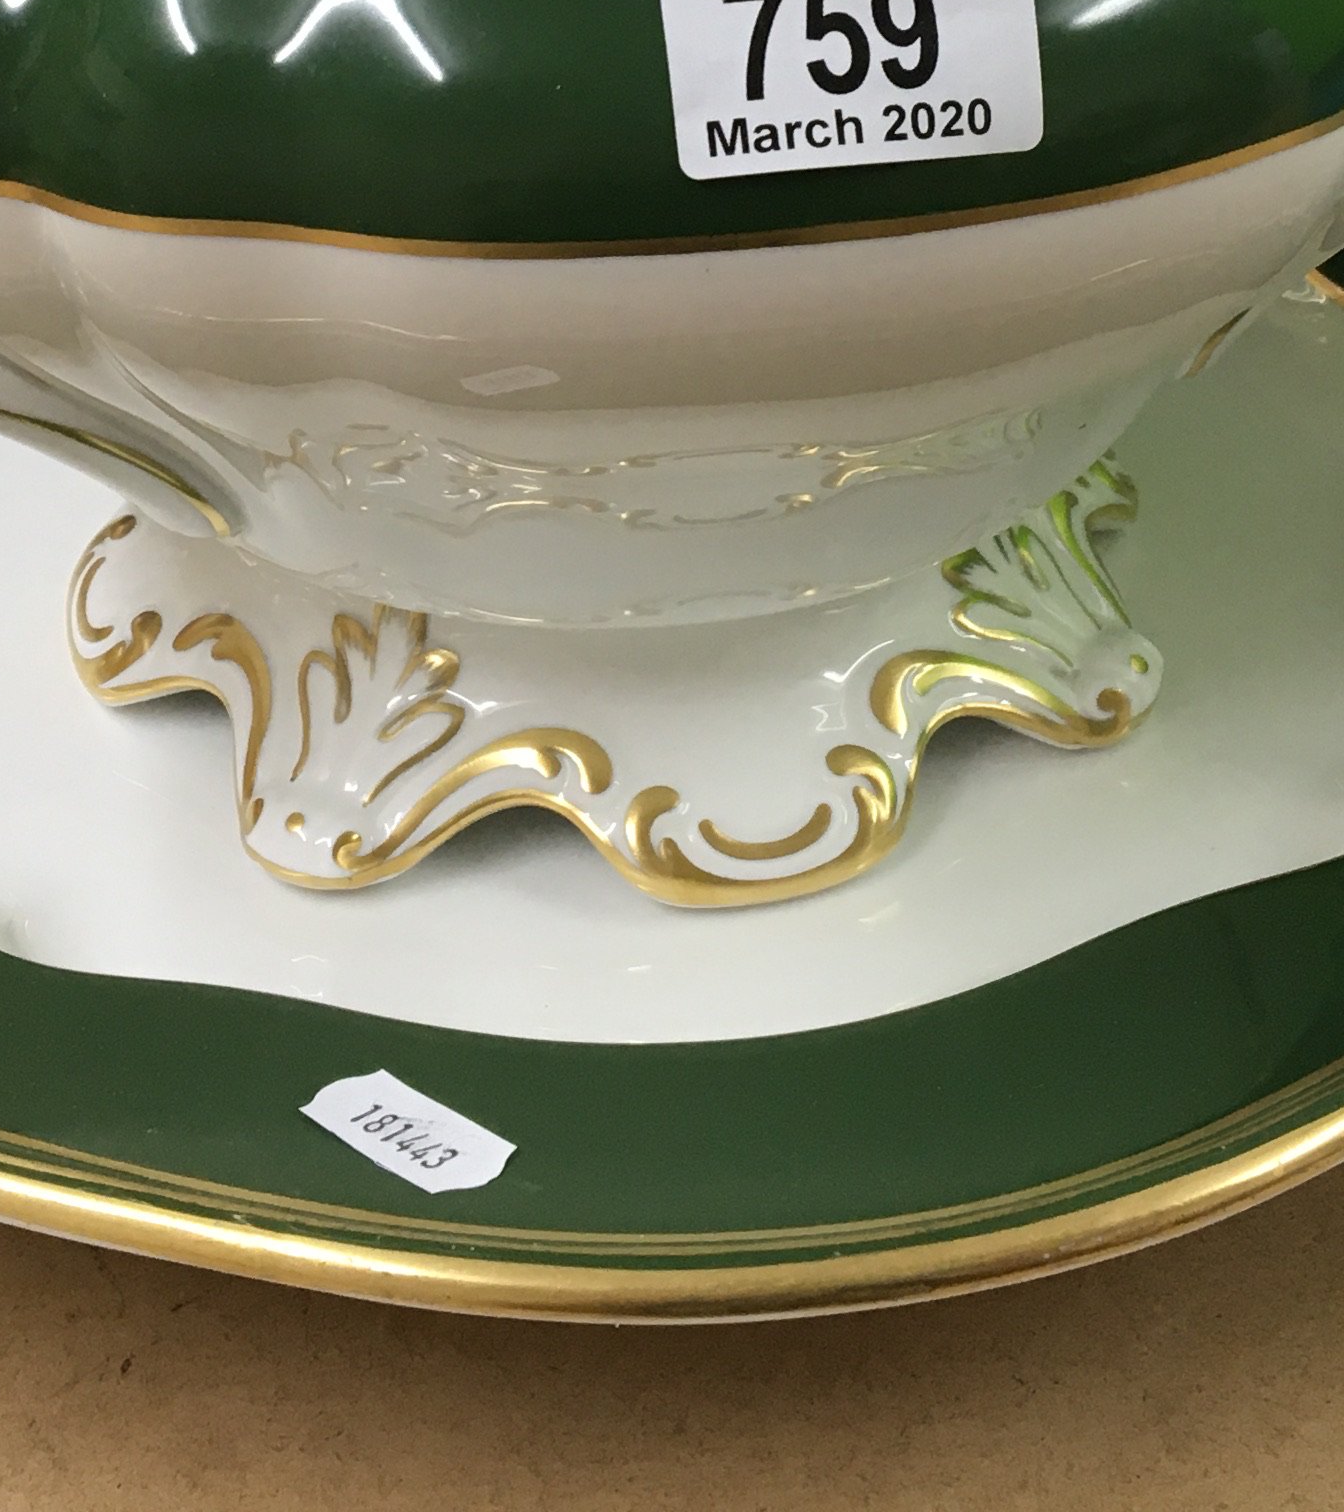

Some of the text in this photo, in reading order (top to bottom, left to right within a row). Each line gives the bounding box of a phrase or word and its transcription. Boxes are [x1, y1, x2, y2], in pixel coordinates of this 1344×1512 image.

[706, 97, 993, 158] March 2020
[349, 1103, 461, 1169] 181443
